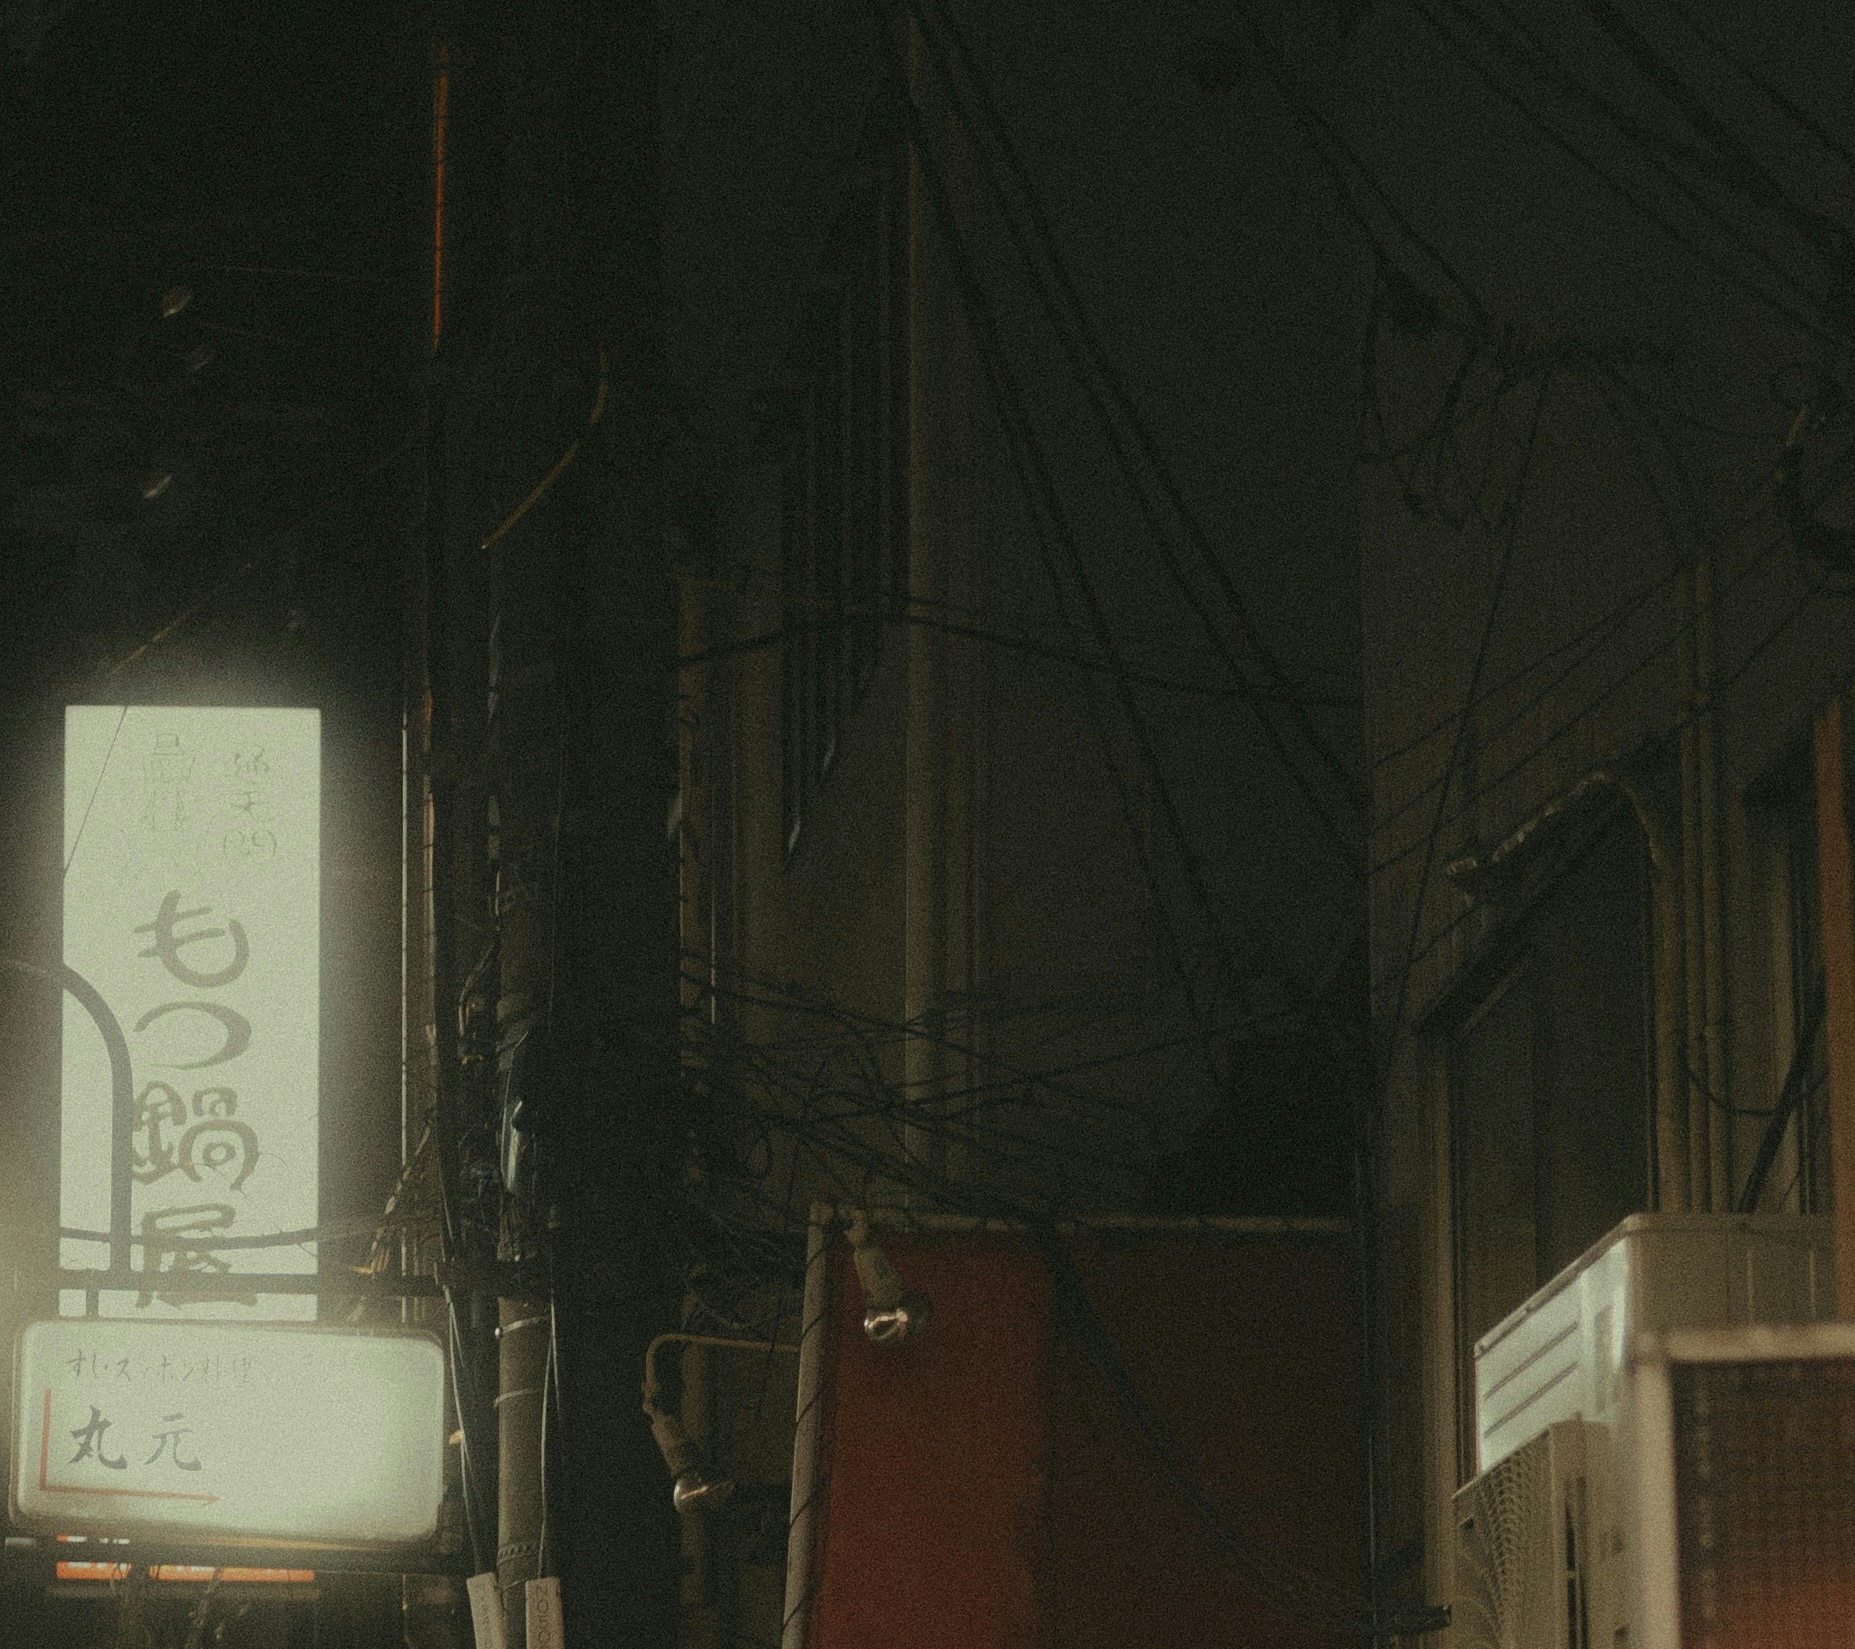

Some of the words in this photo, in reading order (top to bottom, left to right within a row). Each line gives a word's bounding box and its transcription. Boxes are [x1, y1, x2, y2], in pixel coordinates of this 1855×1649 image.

[133, 890, 261, 1310] もつ鍋屋
[67, 1407, 203, 1472] 丸元
